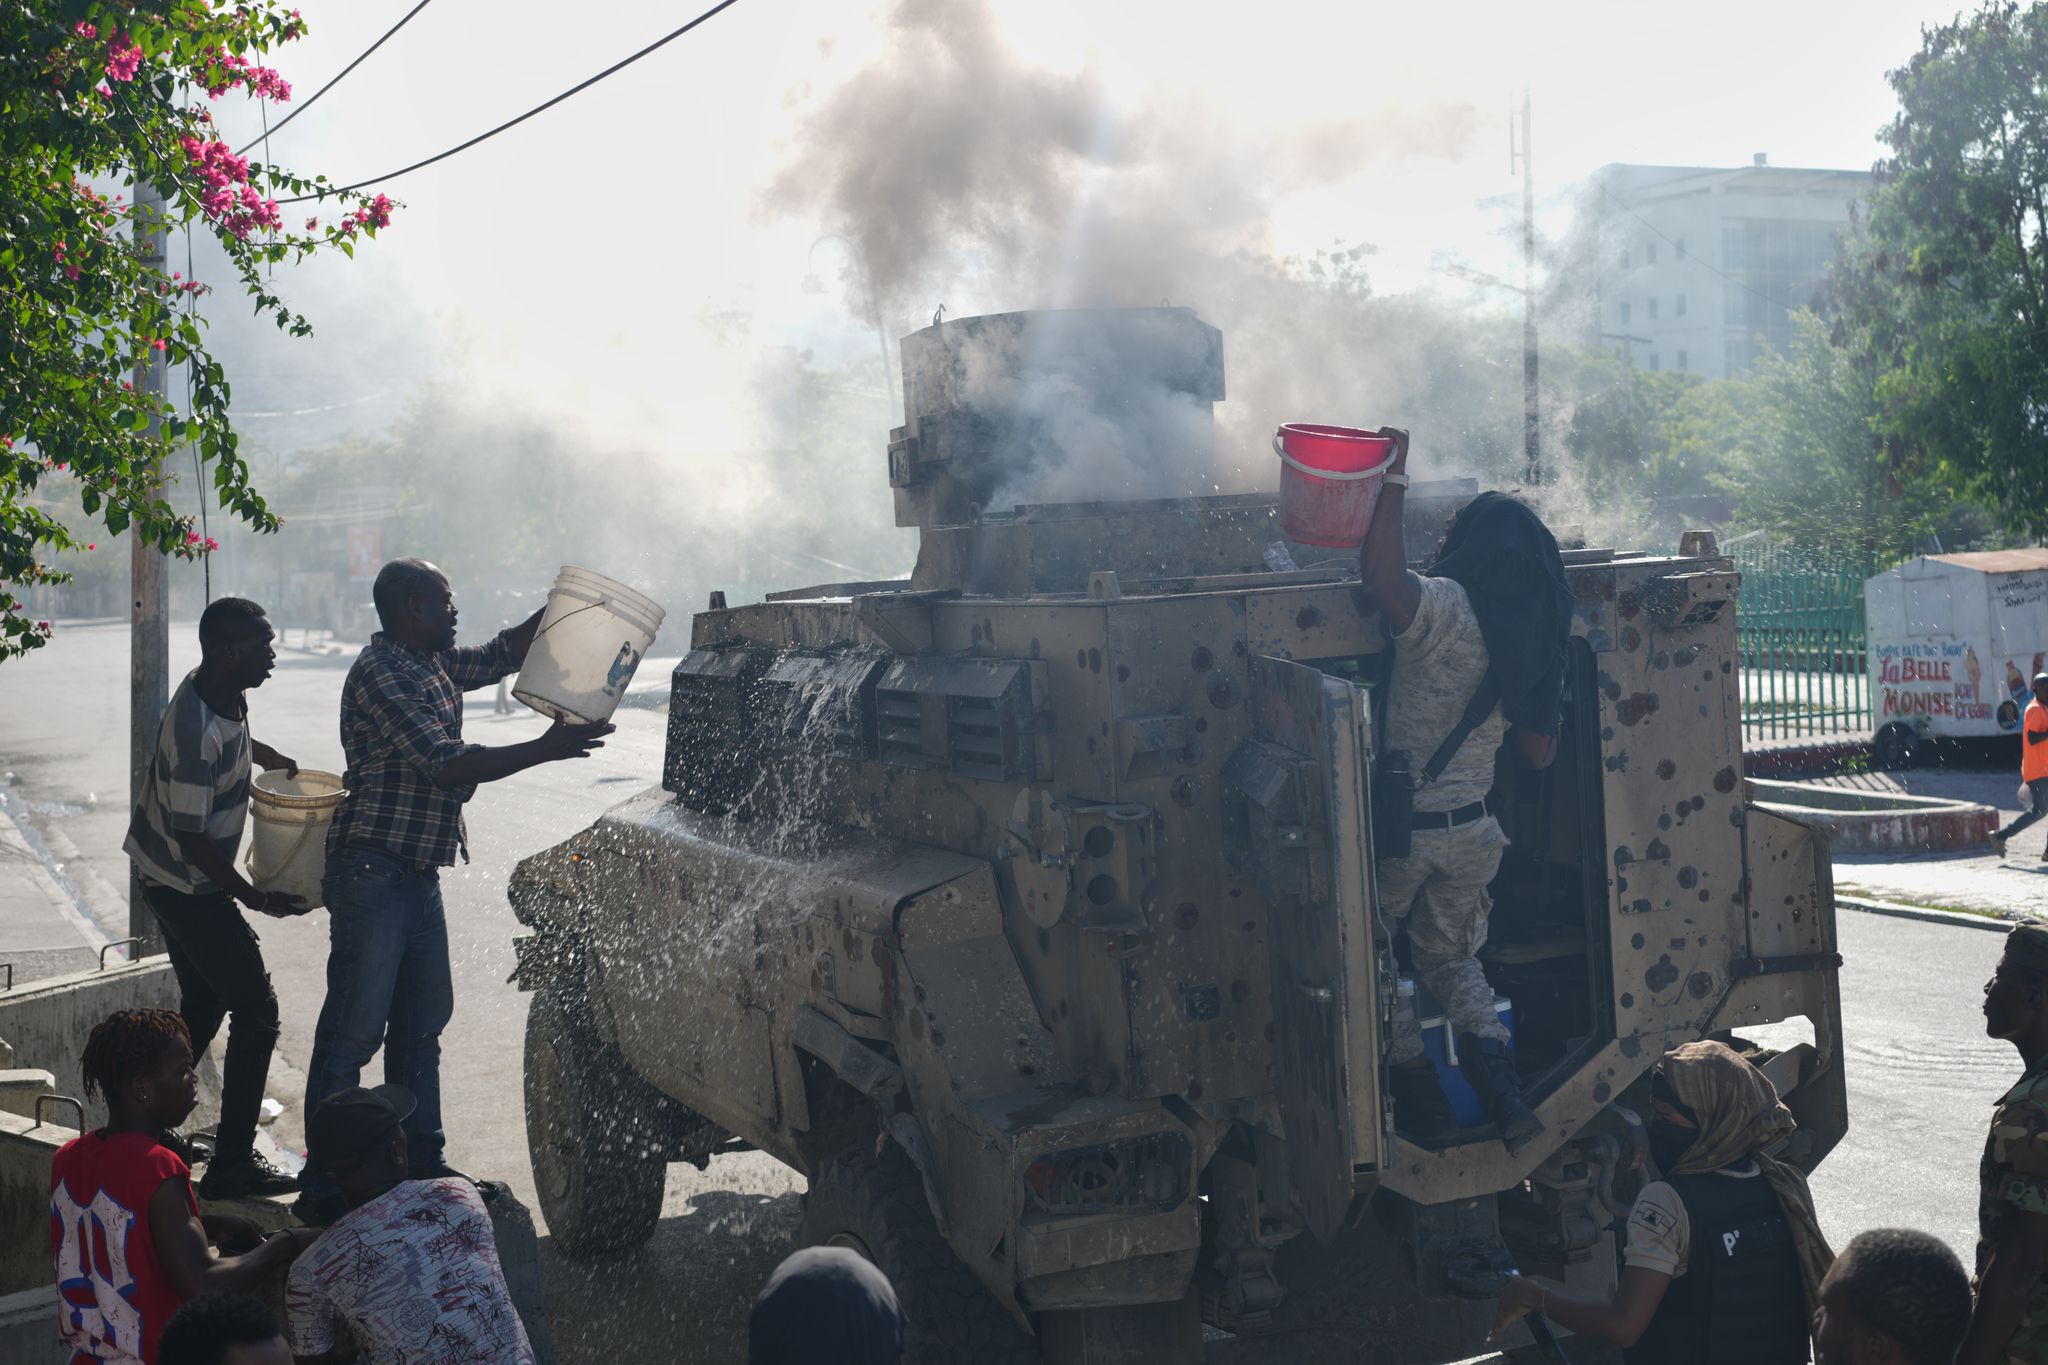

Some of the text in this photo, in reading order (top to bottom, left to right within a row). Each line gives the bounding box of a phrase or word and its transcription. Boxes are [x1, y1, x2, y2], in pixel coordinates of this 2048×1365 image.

[1878, 655, 1952, 684] La BELLE
[1883, 687, 1953, 717] MONISE
